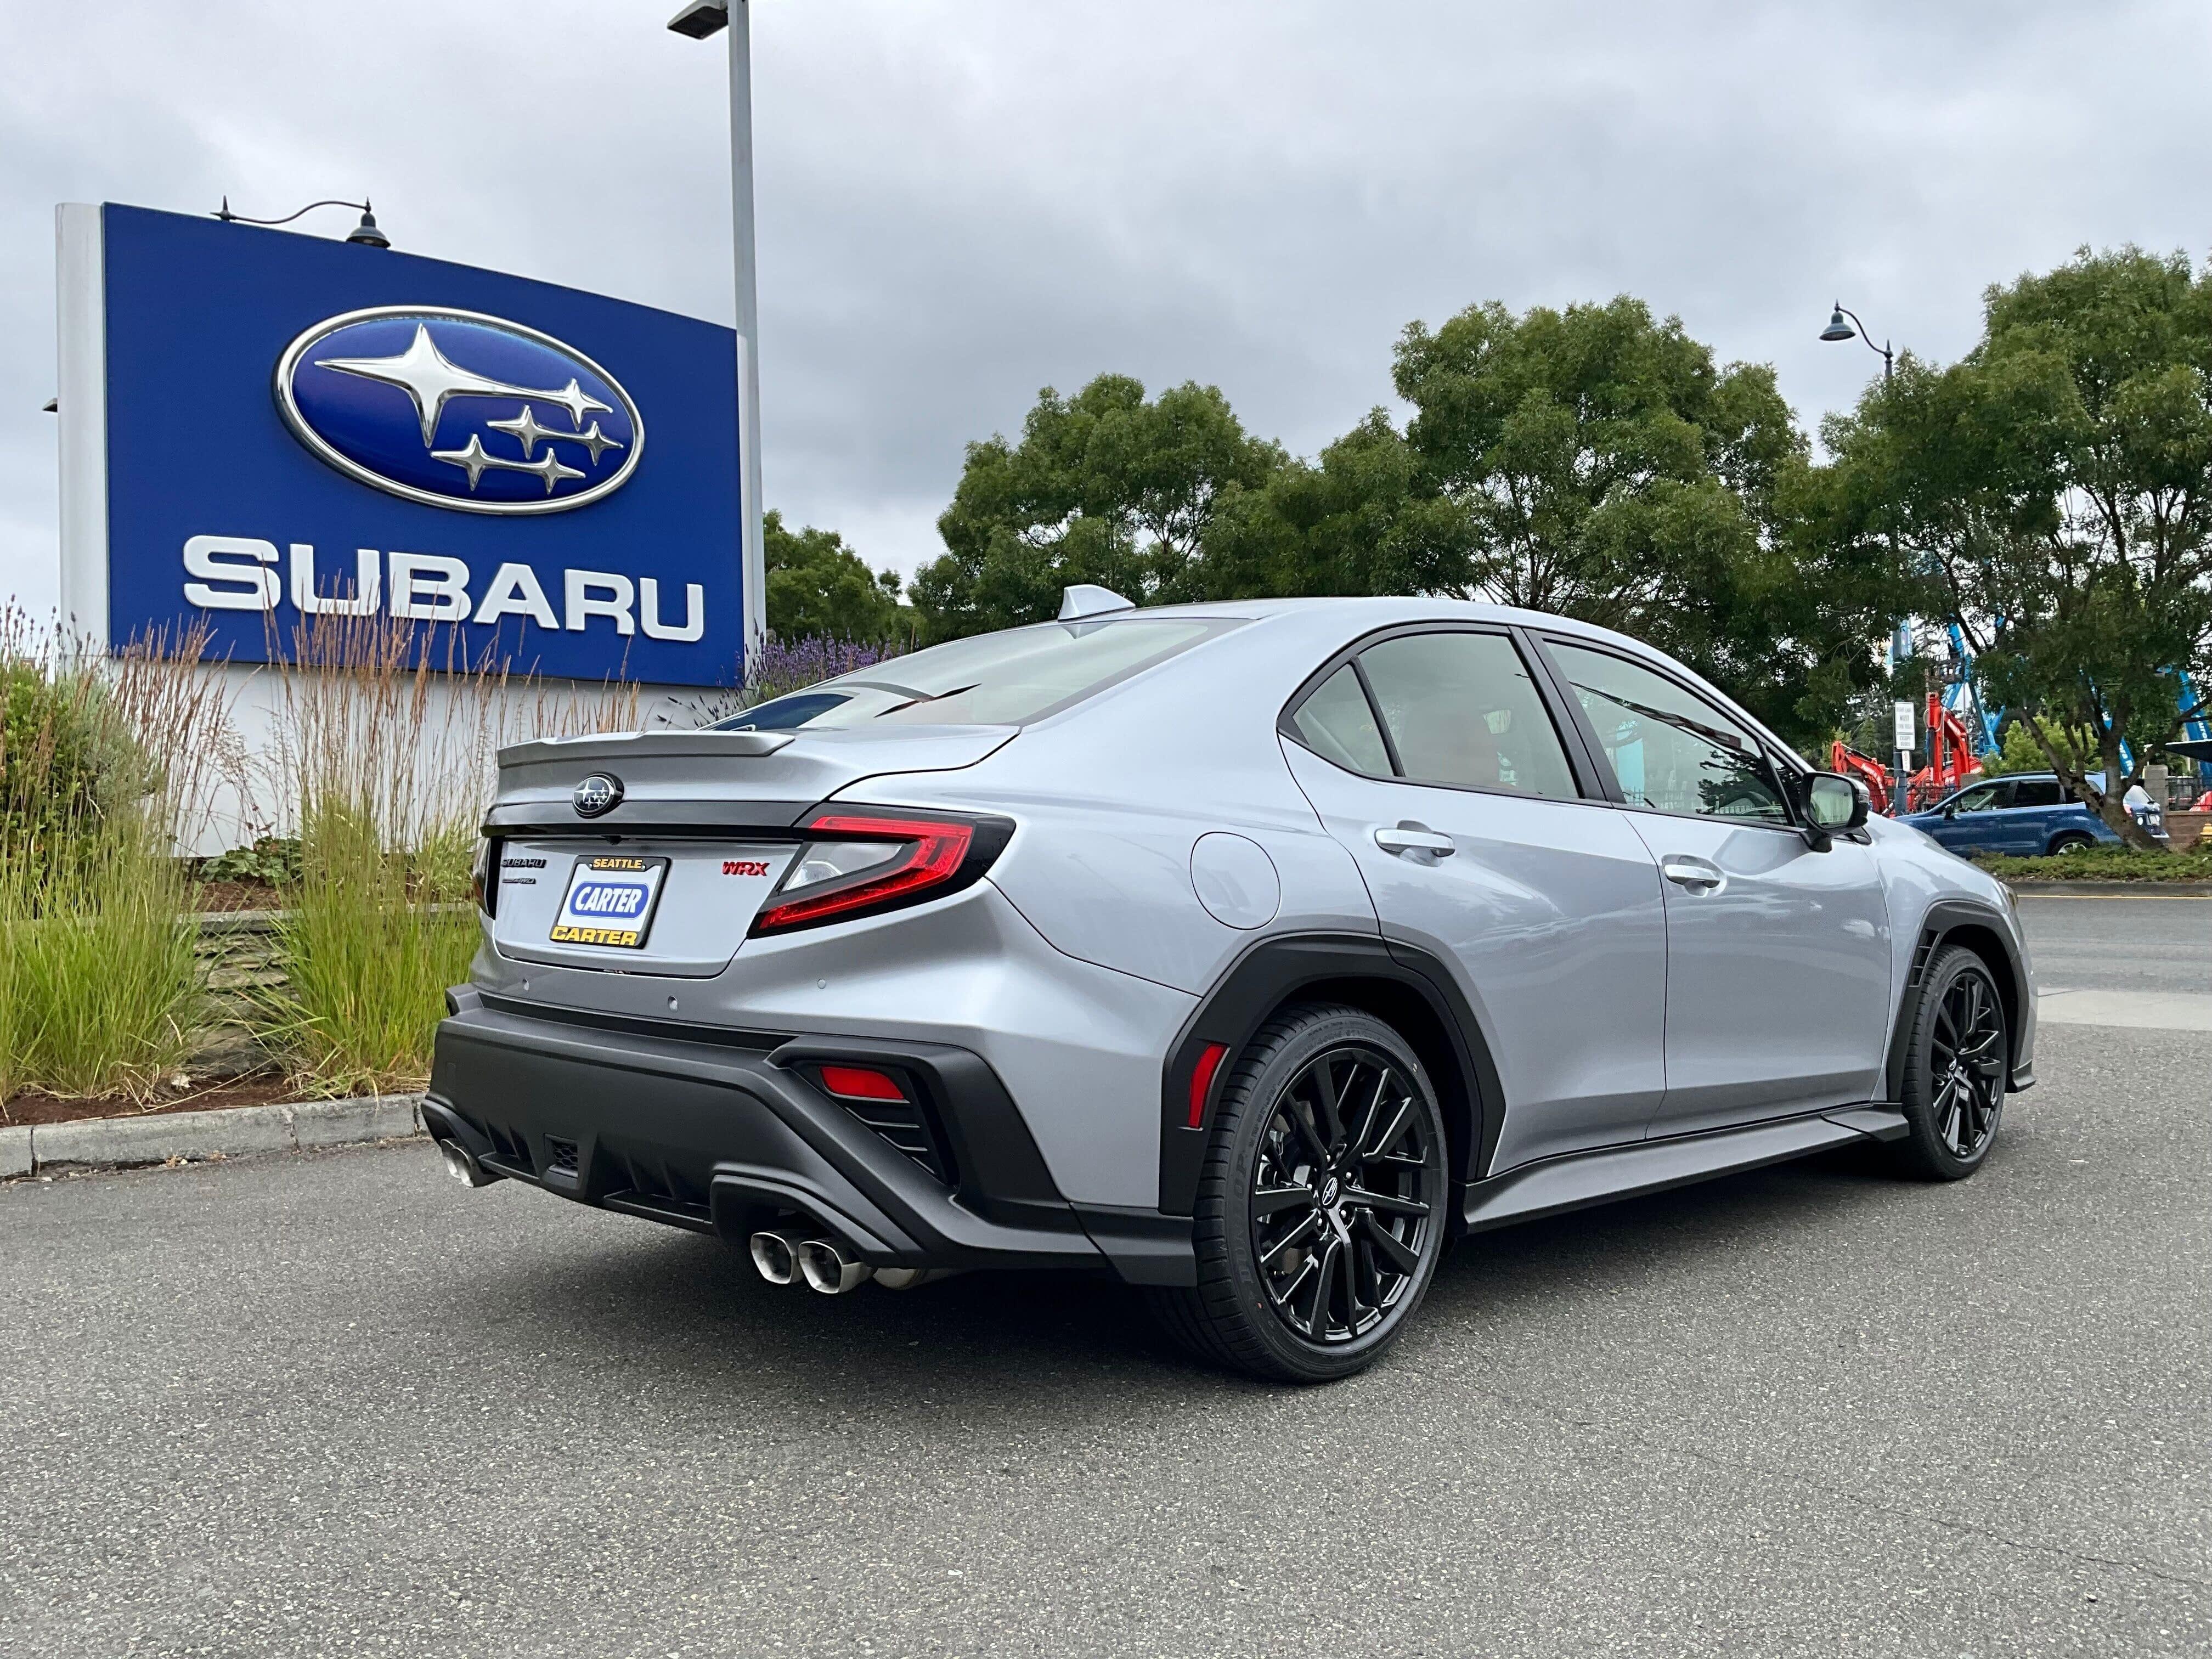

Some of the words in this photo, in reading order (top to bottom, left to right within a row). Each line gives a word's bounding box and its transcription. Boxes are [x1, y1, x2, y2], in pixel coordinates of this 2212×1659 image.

[183, 534, 703, 642] SUBARU
[500, 859, 546, 868] SUBARU
[592, 859, 643, 869] SEATTLE
[722, 861, 770, 876] WRX
[575, 886, 642, 913] CARTER
[551, 926, 637, 946] CARTER
